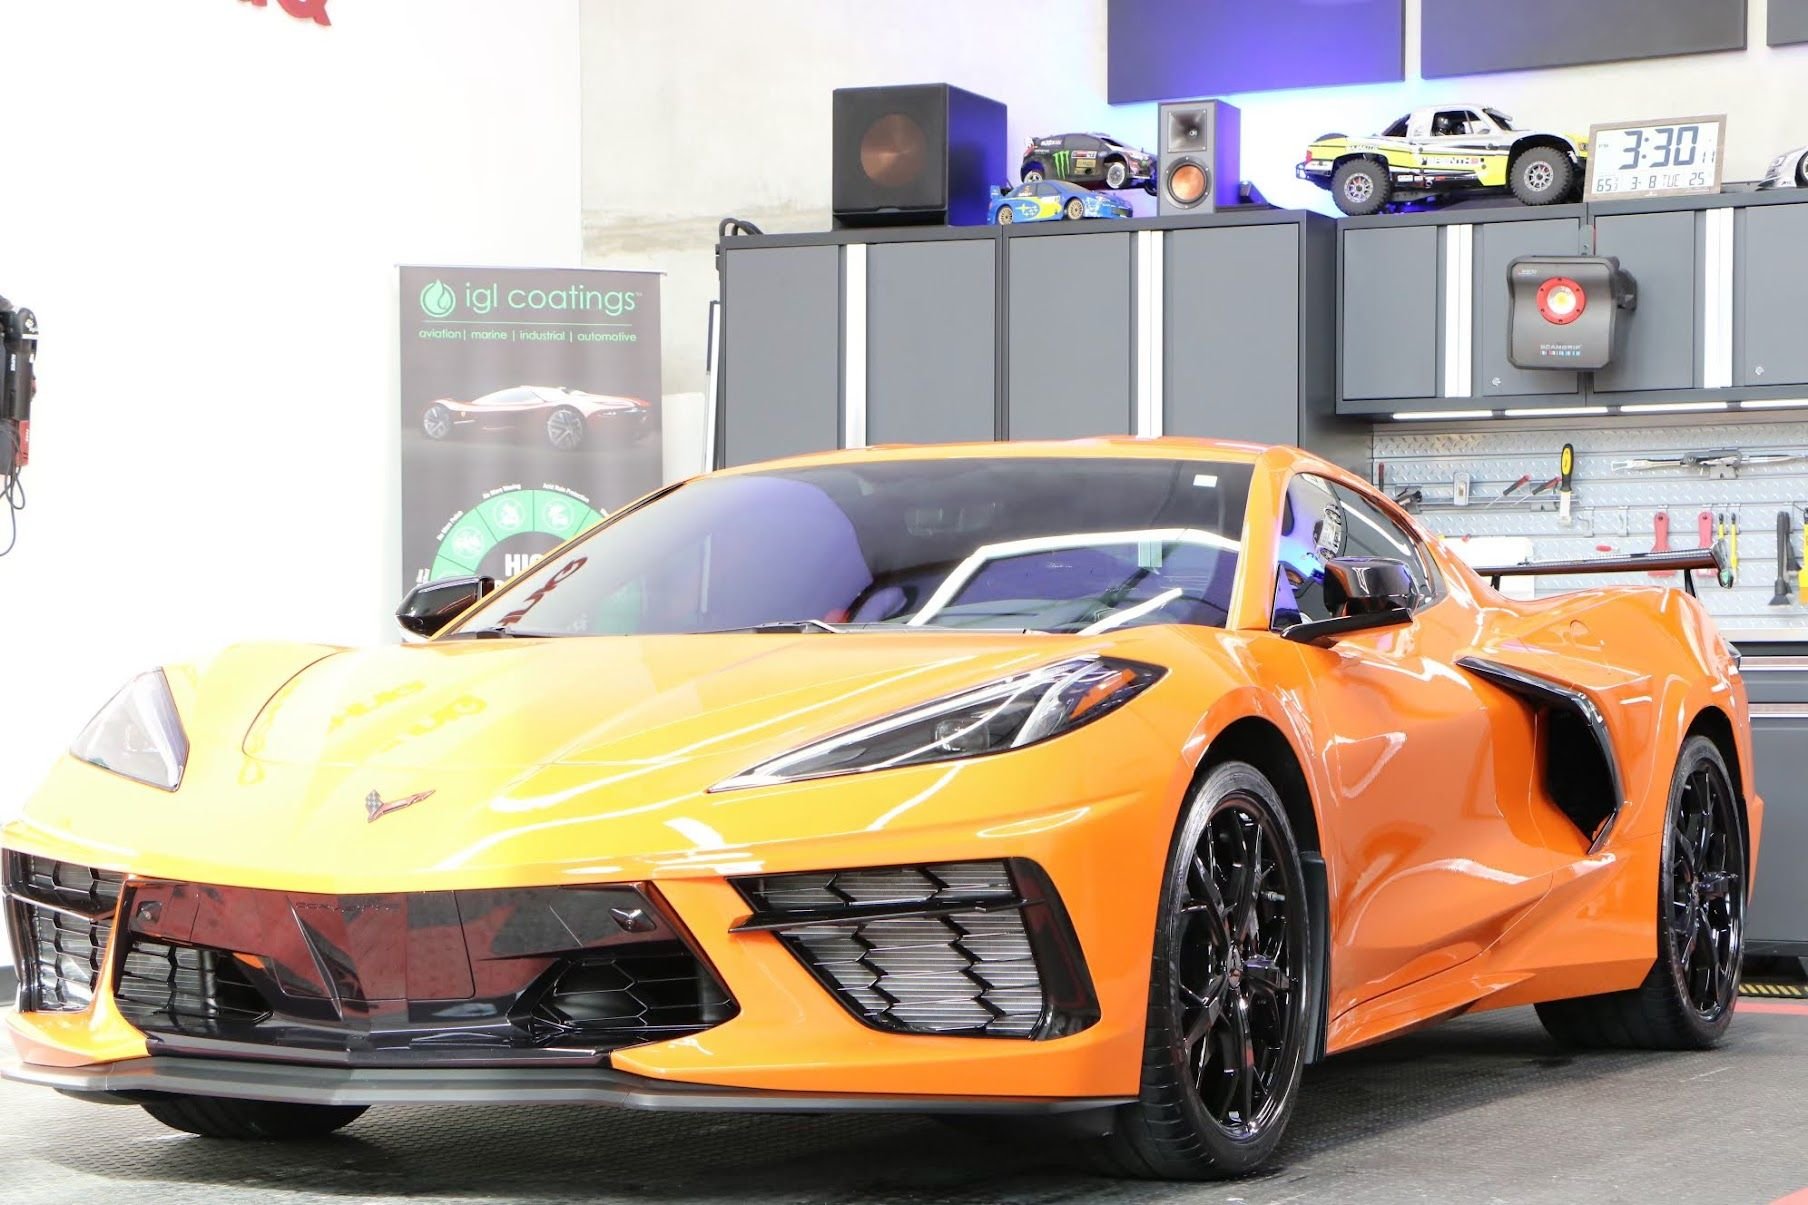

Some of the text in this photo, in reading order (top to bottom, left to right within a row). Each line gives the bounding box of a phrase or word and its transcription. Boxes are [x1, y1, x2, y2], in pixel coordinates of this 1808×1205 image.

[1618, 126, 1699, 170] 3:30
[465, 282, 636, 317] igl coatings
[419, 328, 637, 342] aviation marine industrial automotive
